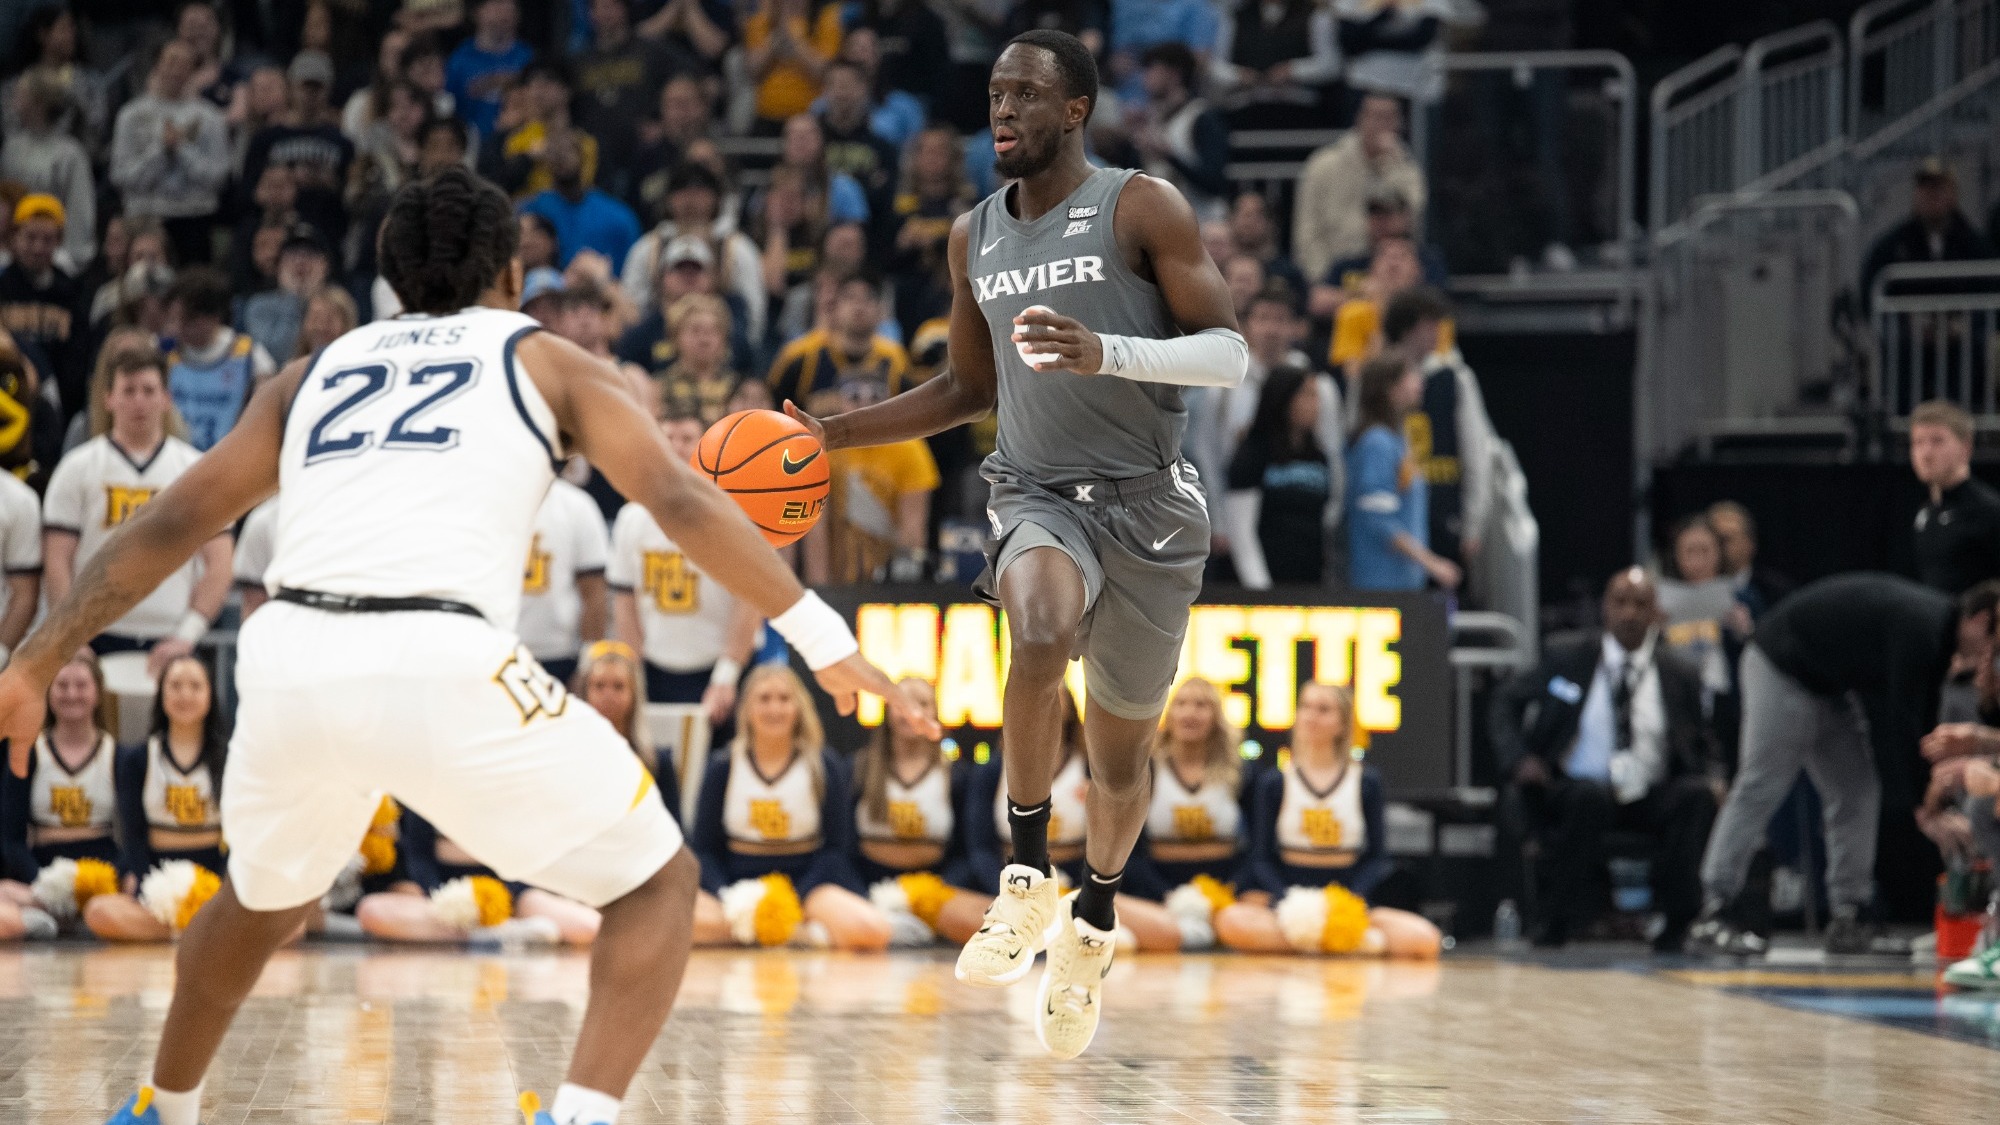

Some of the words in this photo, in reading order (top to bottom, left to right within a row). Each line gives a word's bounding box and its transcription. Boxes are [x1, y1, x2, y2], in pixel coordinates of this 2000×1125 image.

[975, 255, 1106, 303] XAVIER
[366, 326, 467, 352] JONES
[304, 356, 482, 467] 22
[1073, 484, 1095, 502] X
[856, 603, 1401, 731] MAETTE
